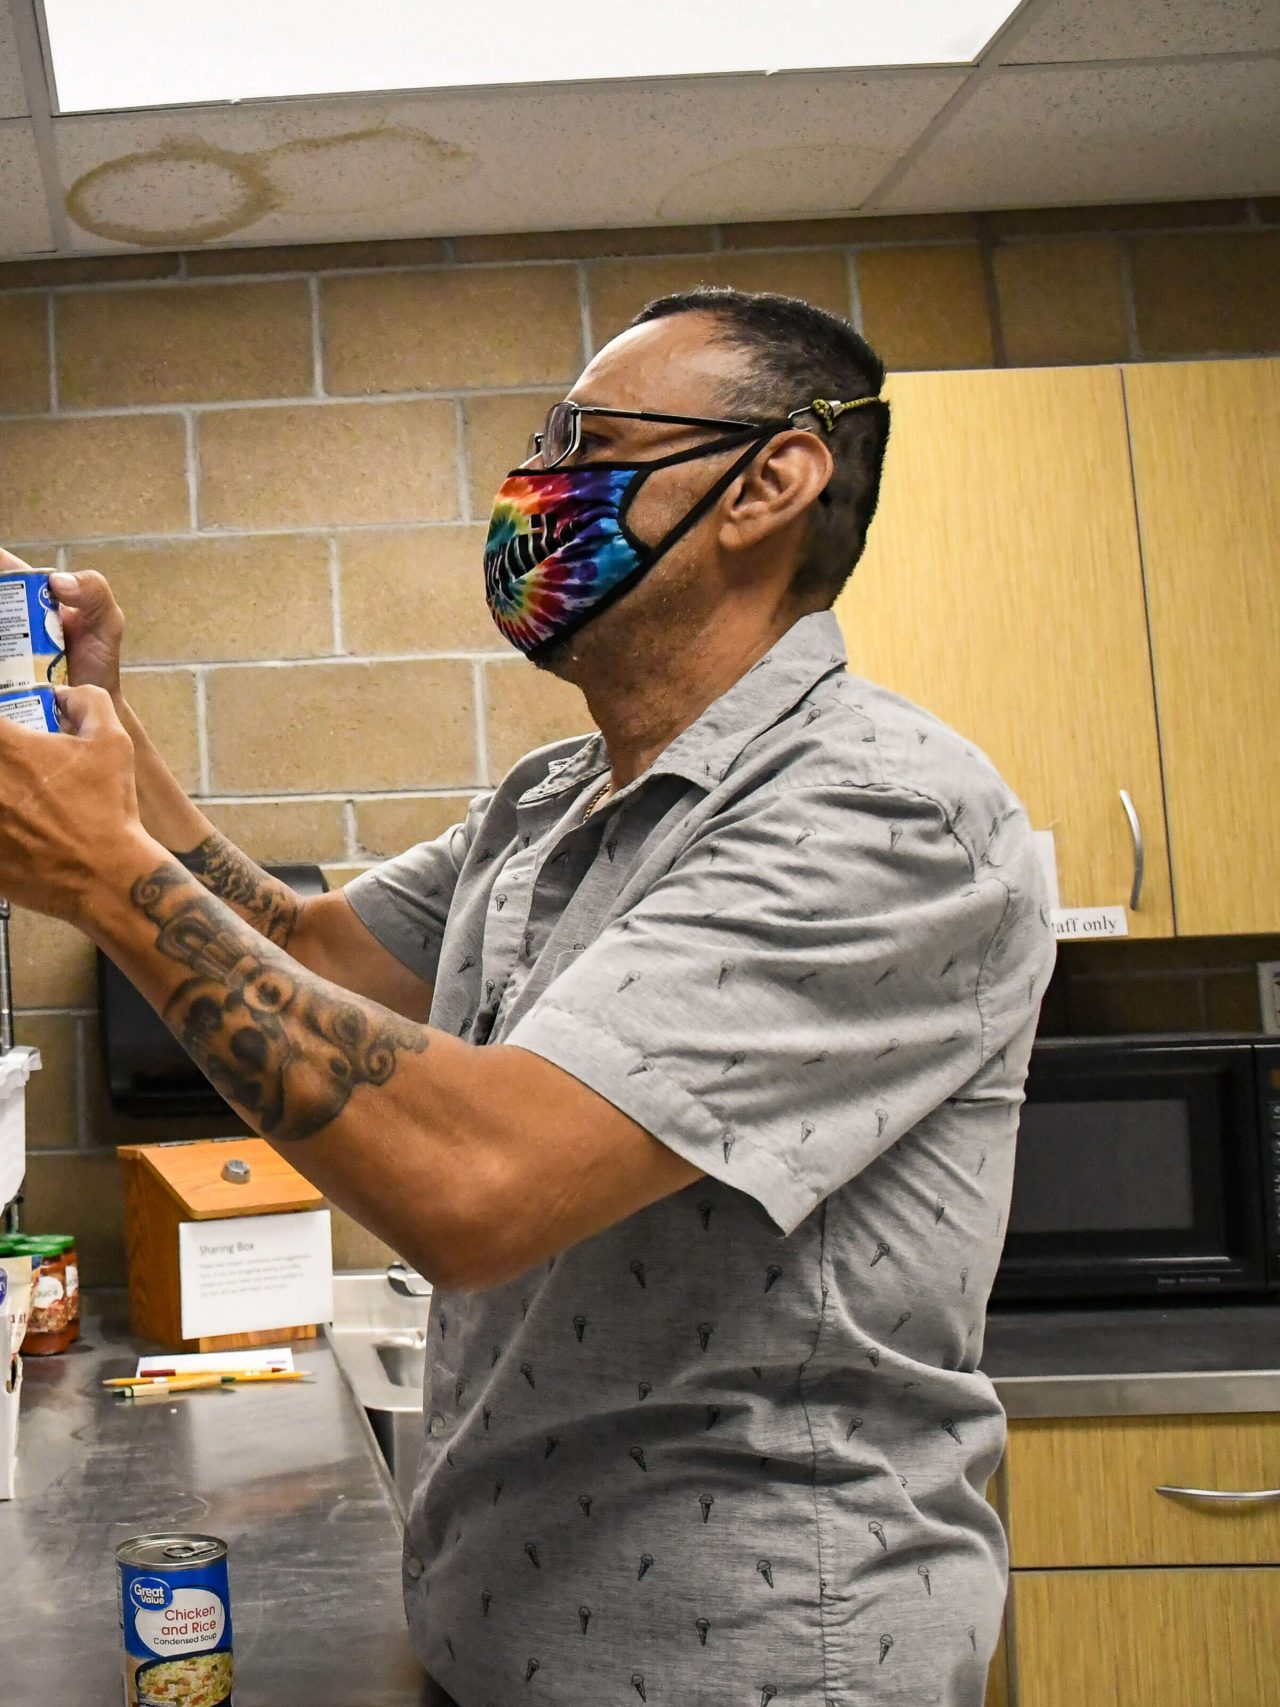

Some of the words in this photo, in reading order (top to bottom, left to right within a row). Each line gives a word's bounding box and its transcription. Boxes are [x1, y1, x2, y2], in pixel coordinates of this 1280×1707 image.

[1082, 914, 1117, 934] only
[199, 1244, 235, 1256] Sharing
[237, 1241, 255, 1252] Box
[134, 1583, 165, 1598] Great
[140, 1595, 165, 1605] Value
[164, 1605, 216, 1621] Chicken
[161, 1623, 188, 1636] and
[191, 1620, 217, 1634] Rice
[153, 1635, 200, 1645] Condensed
[200, 1632, 218, 1643] Soup
